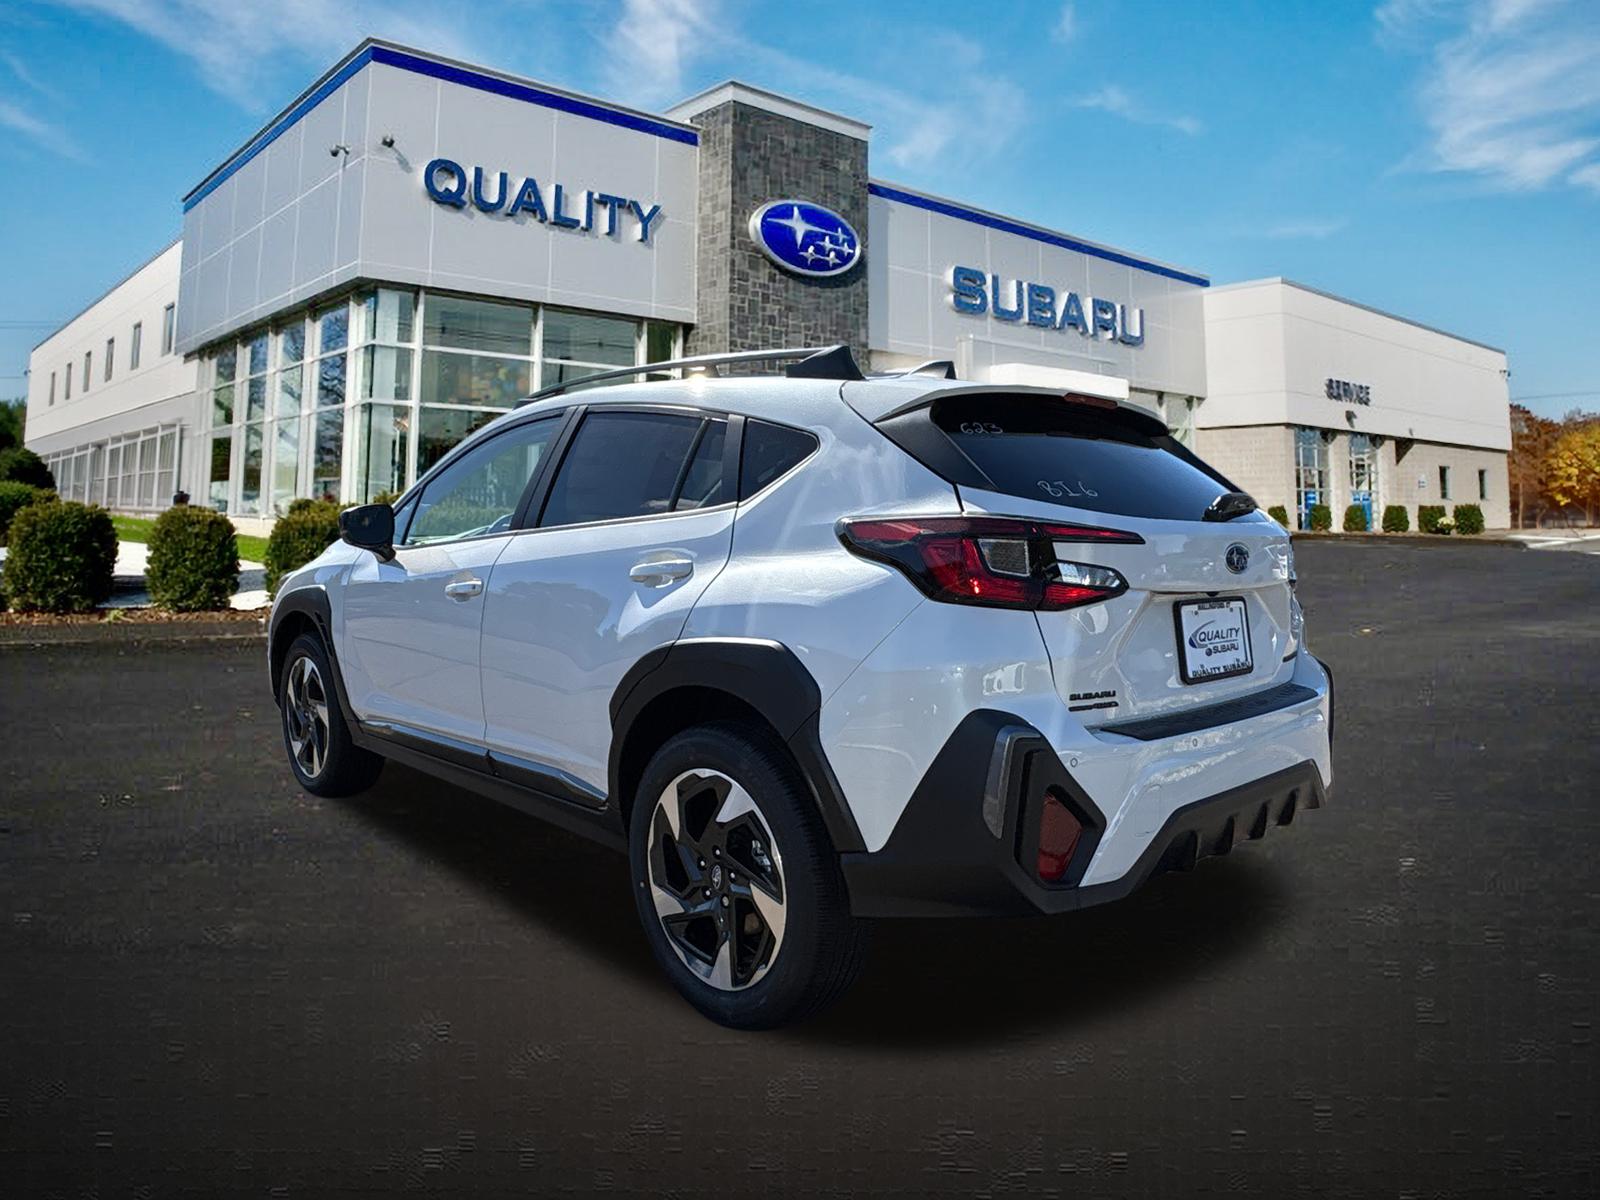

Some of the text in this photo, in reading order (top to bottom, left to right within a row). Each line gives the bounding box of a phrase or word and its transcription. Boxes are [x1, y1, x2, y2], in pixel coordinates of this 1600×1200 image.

[424, 157, 661, 243] QUALITY
[952, 265, 1145, 346] SUBARU
[1325, 377, 1371, 407] SERVICE
[1199, 627, 1240, 642] QUALITY
[1212, 643, 1239, 654] SUBARU
[1192, 661, 1250, 677] QUALITY SUBARU
[1069, 690, 1116, 701] SUBARU
